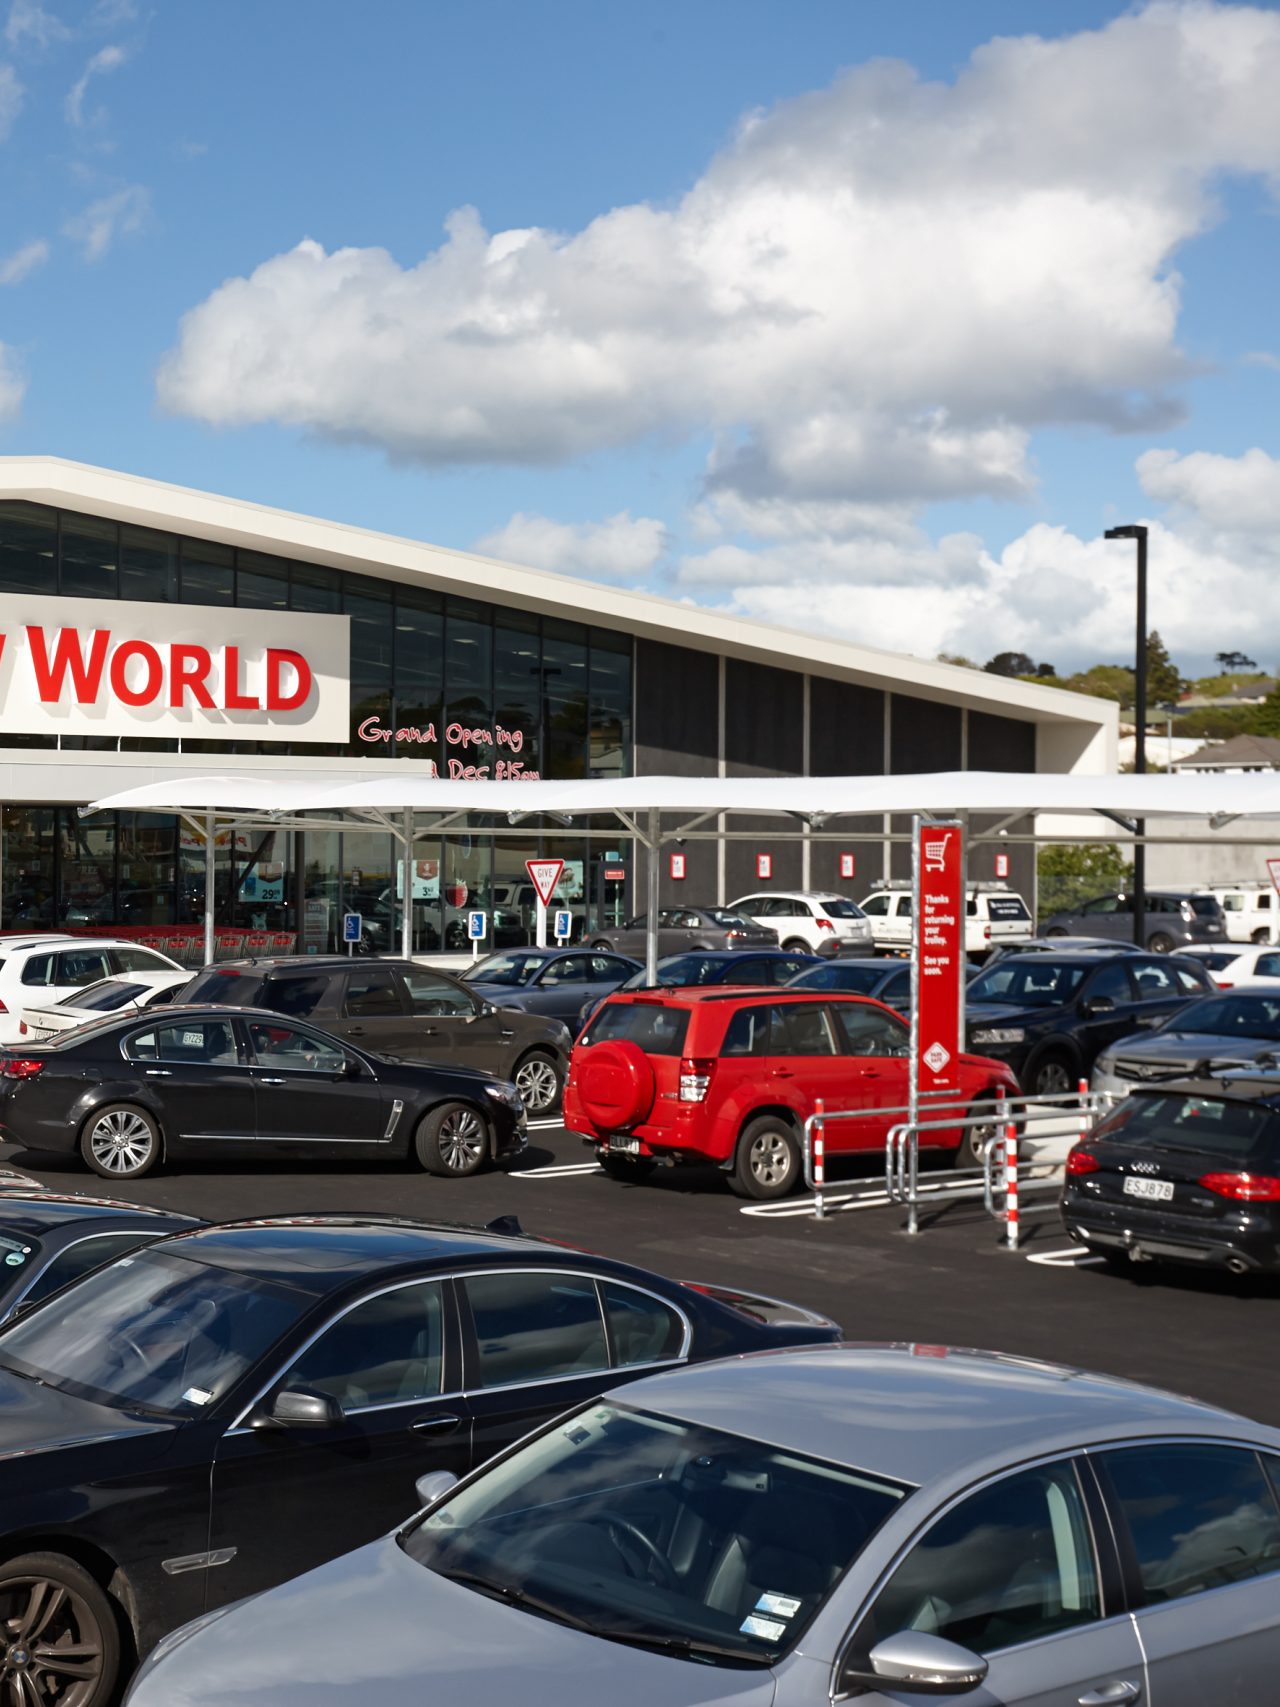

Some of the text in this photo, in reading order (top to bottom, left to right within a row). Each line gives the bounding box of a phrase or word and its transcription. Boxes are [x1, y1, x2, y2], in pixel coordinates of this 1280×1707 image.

[26, 625, 313, 712] WORLD
[357, 715, 524, 753] Grand Opening
[447, 758, 490, 781] Dec
[537, 867, 554, 879] GIVE
[924, 894, 950, 904] Thanks
[924, 904, 935, 914] for
[924, 914, 955, 926] returning
[924, 926, 940, 937] your
[924, 955, 950, 966] See you
[1125, 1178, 1172, 1199] ESJ878
